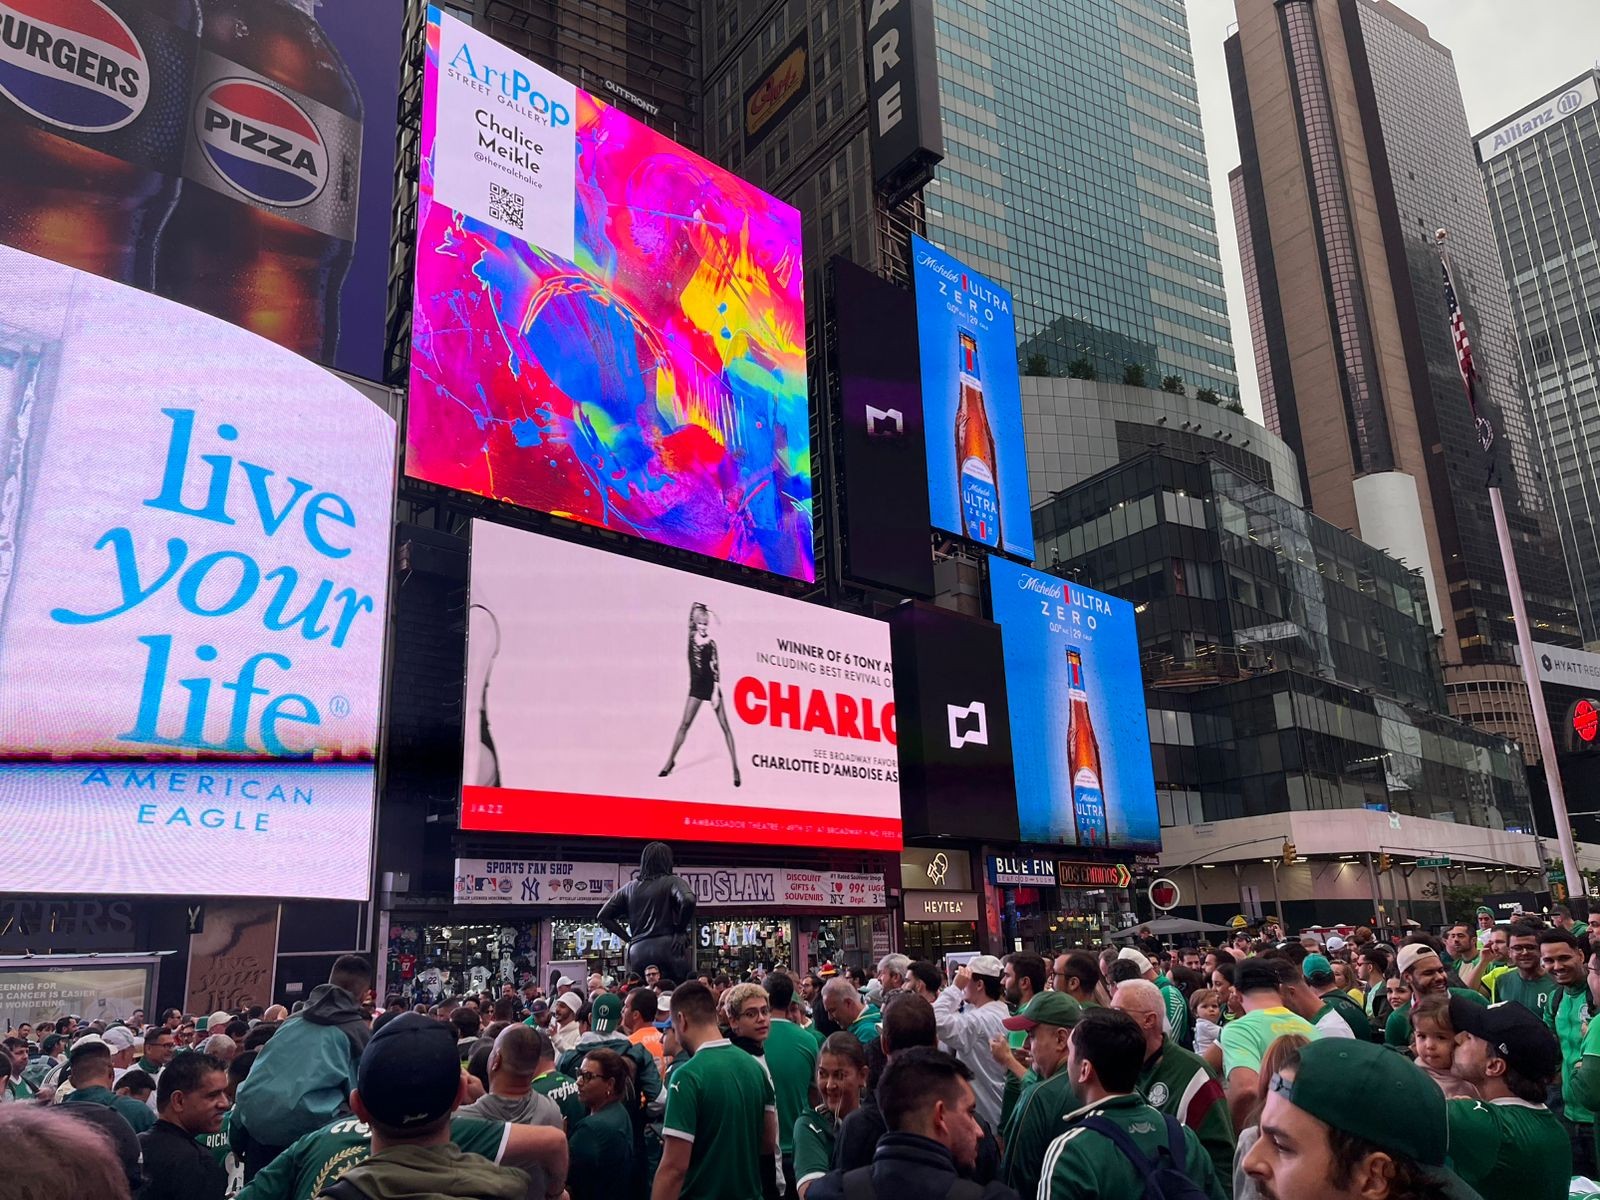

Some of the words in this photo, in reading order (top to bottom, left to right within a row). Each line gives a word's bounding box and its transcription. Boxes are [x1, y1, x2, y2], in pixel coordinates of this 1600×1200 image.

[0, 13, 140, 98] URGERS
[447, 68, 491, 97] STREET
[497, 94, 548, 126] GALLERY
[448, 42, 570, 128] ArtPop
[203, 106, 318, 178] PIZZA
[475, 108, 544, 155] Chalice
[1493, 108, 1554, 151] Allianz
[477, 131, 541, 174] Meikle
[473, 151, 543, 190] @therealchalice
[917, 251, 959, 284] Michelob
[969, 280, 1009, 315] ULTRA
[143, 407, 357, 559] live
[963, 490, 998, 514] ULTRA
[49, 526, 373, 649] your
[1018, 573, 1062, 599] Michelob
[1071, 589, 1113, 617] ULTRA
[1040, 600, 1097, 630] ZERO
[756, 652, 817, 674] INCLUDING
[820, 664, 842, 680] BEST
[844, 669, 882, 687] REVIVAL
[777, 638, 825, 660] WINNER
[827, 649, 842, 663] OF
[844, 652, 851, 665] 6
[853, 655, 882, 673] TONY
[1554, 659, 1582, 674] HYATT
[752, 754, 820, 774] CHARLOTTE
[822, 762, 883, 781] D'AMBOISE
[885, 770, 899, 783] AS
[813, 749, 827, 759] SEE
[830, 751, 871, 766] BROADWAY
[81, 765, 314, 806] AMERICAN
[137, 803, 270, 832] EAGLE
[1076, 803, 1103, 816] ULTRA
[486, 861, 524, 874] SPORTS
[527, 862, 546, 875] FAN
[549, 863, 573, 876] SHOP
[786, 873, 822, 882] DISCOUNT
[996, 857, 1029, 874] BLUE
[1033, 860, 1054, 875] FIN
[1061, 865, 1080, 883] DOS
[1081, 866, 1119, 884] CAMINOS
[784, 892, 824, 901] SOUVENIRS
[790, 883, 809, 892] GIFTS
[811, 883, 816, 892] &
[830, 894, 845, 904] NY
[701, 922, 757, 947] SLAM
[37, 982, 57, 990] FOR
[191, 968, 267, 995] your
[428, 976, 437, 985] 22
[5, 1000, 65, 1009] WONDERING
[6, 991, 46, 1000] CANCER
[61, 990, 96, 998] EASIER
[330, 1119, 373, 1138] cre
